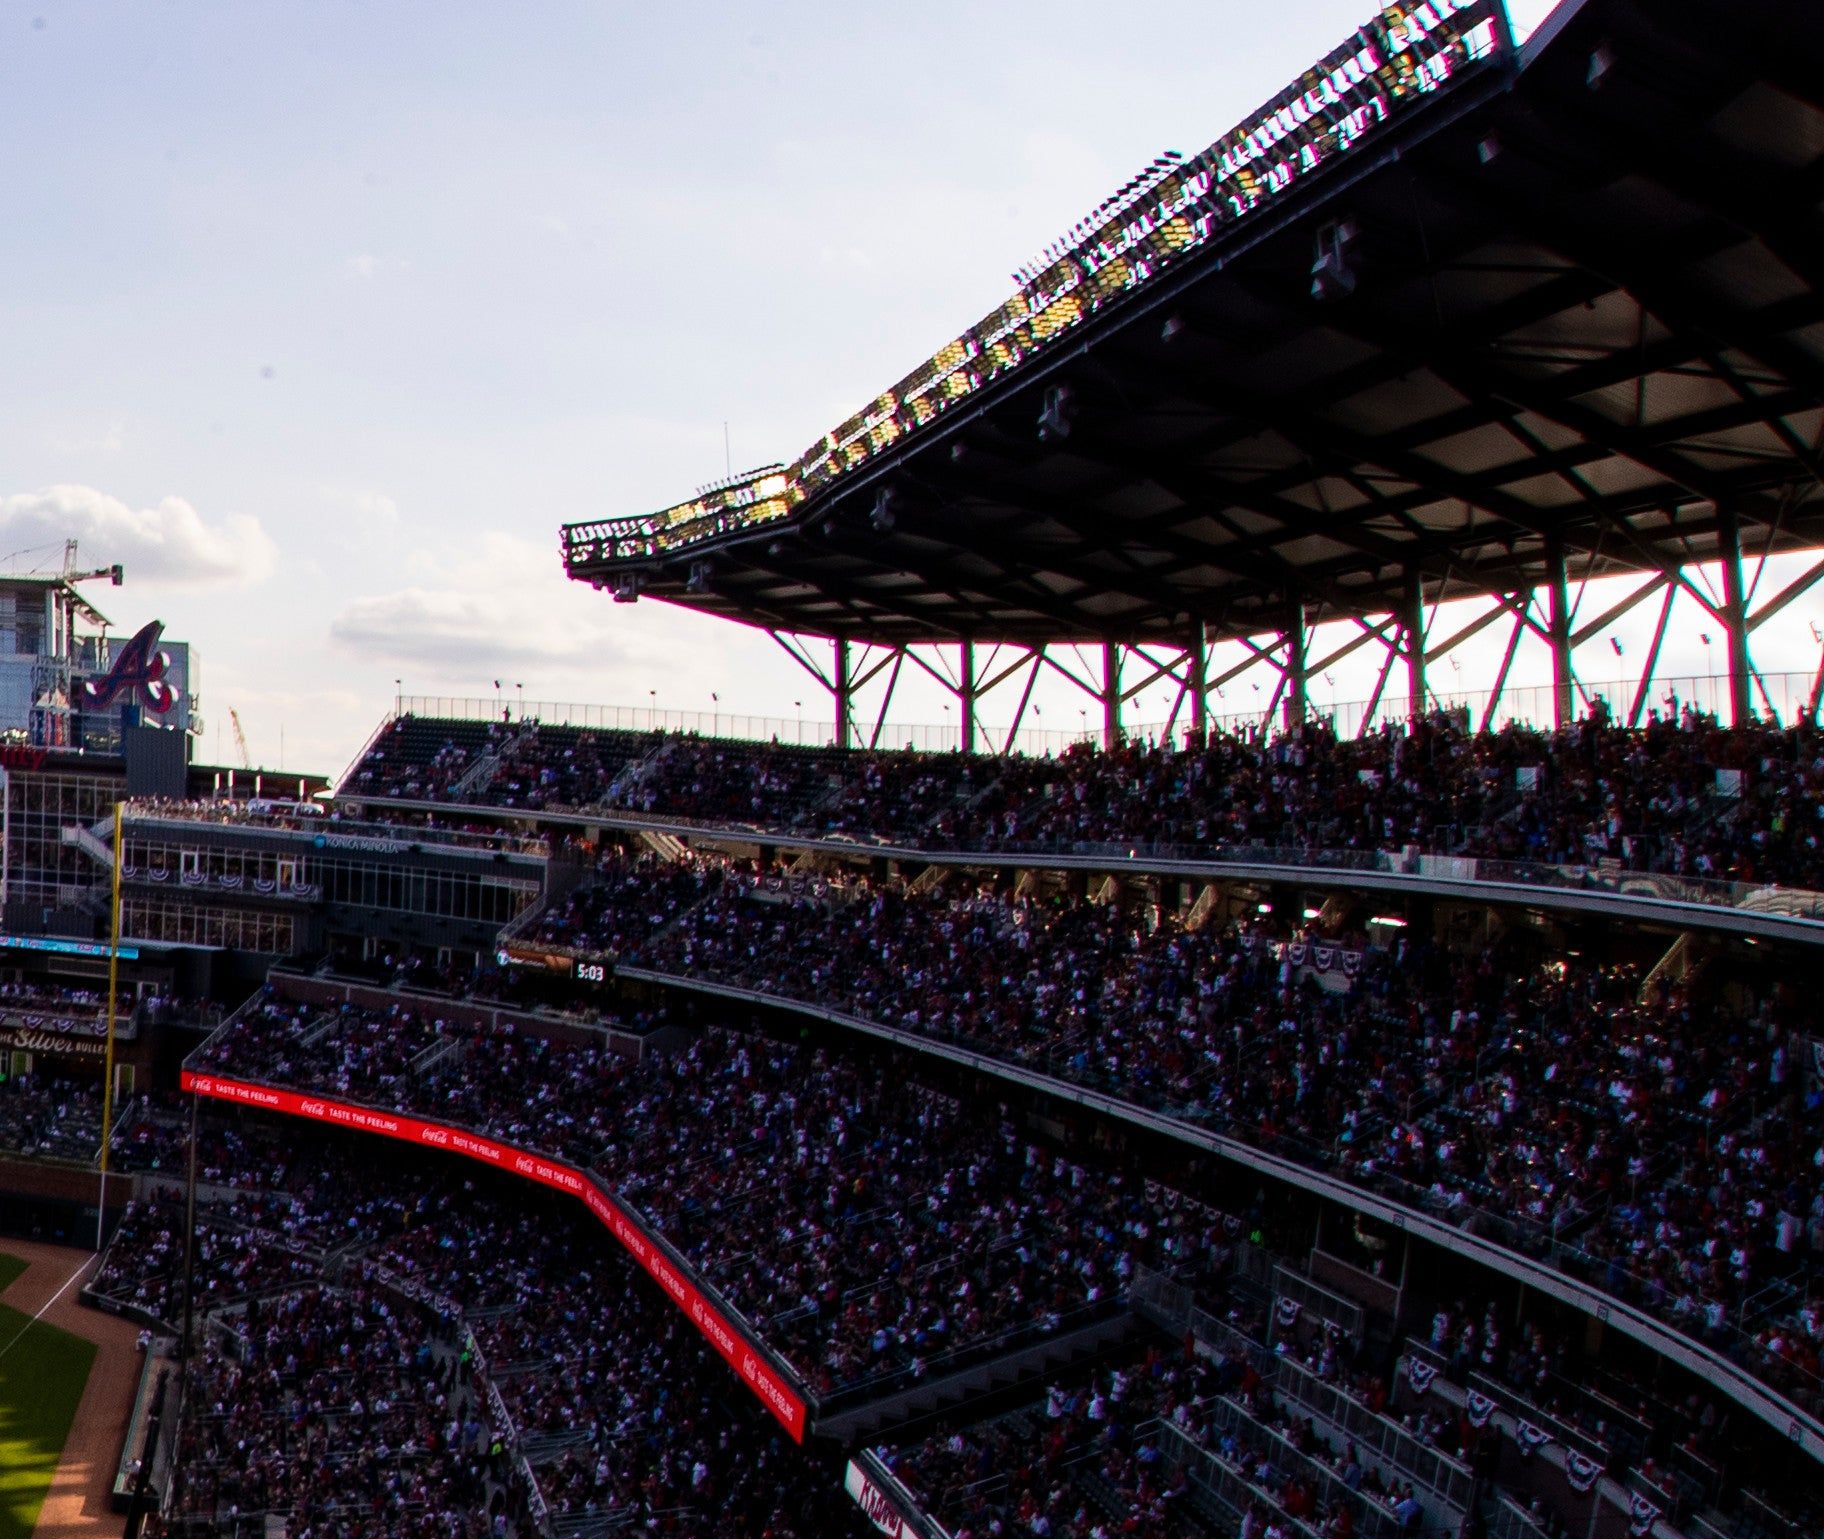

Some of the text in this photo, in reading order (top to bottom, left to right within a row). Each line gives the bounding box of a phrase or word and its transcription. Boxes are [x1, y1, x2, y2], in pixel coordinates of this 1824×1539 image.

[577, 963, 604, 980] 5:03
[12, 1029, 75, 1053] Silver
[216, 1084, 279, 1105] TASTE THE FEELING
[329, 1108, 398, 1131] TASTE THE FEELING
